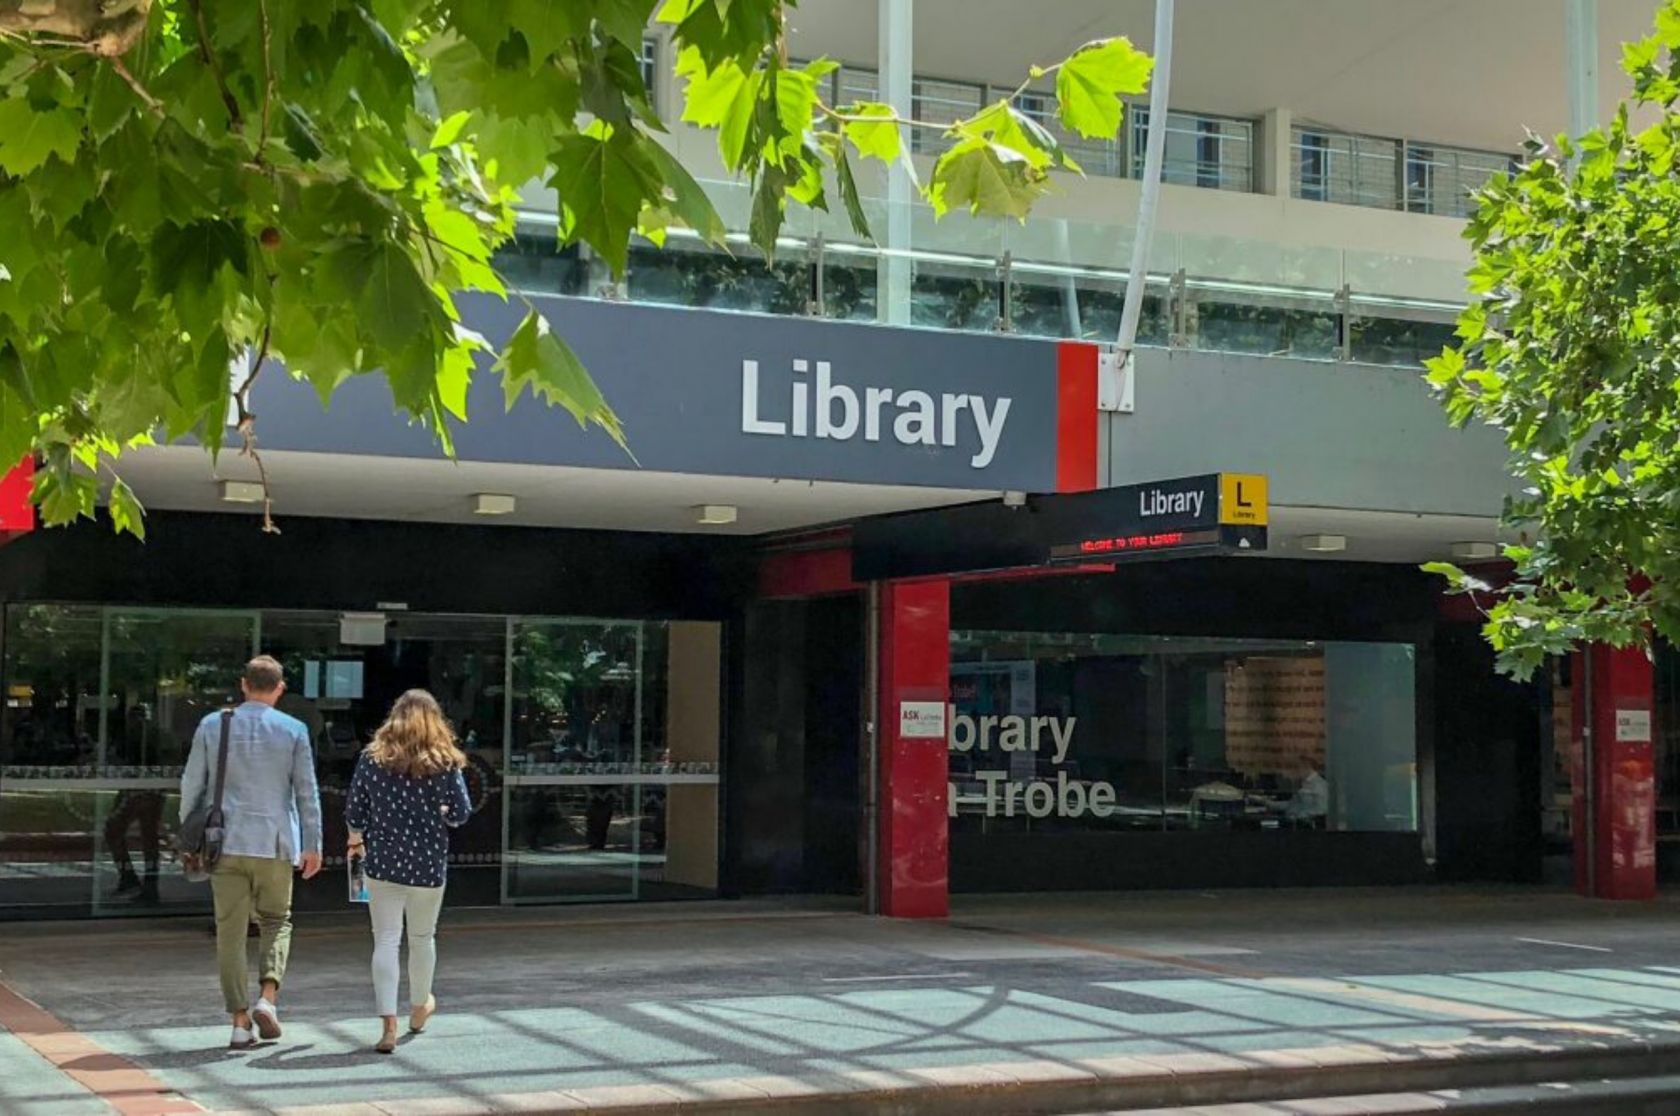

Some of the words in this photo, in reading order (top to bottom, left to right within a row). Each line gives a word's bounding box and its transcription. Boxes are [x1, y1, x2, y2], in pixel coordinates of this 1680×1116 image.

[742, 359, 1012, 469] Library
[1140, 490, 1205, 517] Library
[1237, 481, 1252, 507] L
[1233, 511, 1256, 520] Library
[1081, 540, 1112, 551] WELCOME
[1116, 538, 1125, 548] TO
[1128, 536, 1147, 547] YOUR
[1150, 533, 1183, 545] LIBRARY
[948, 703, 1077, 764] brary
[975, 770, 1116, 818] Trobe
